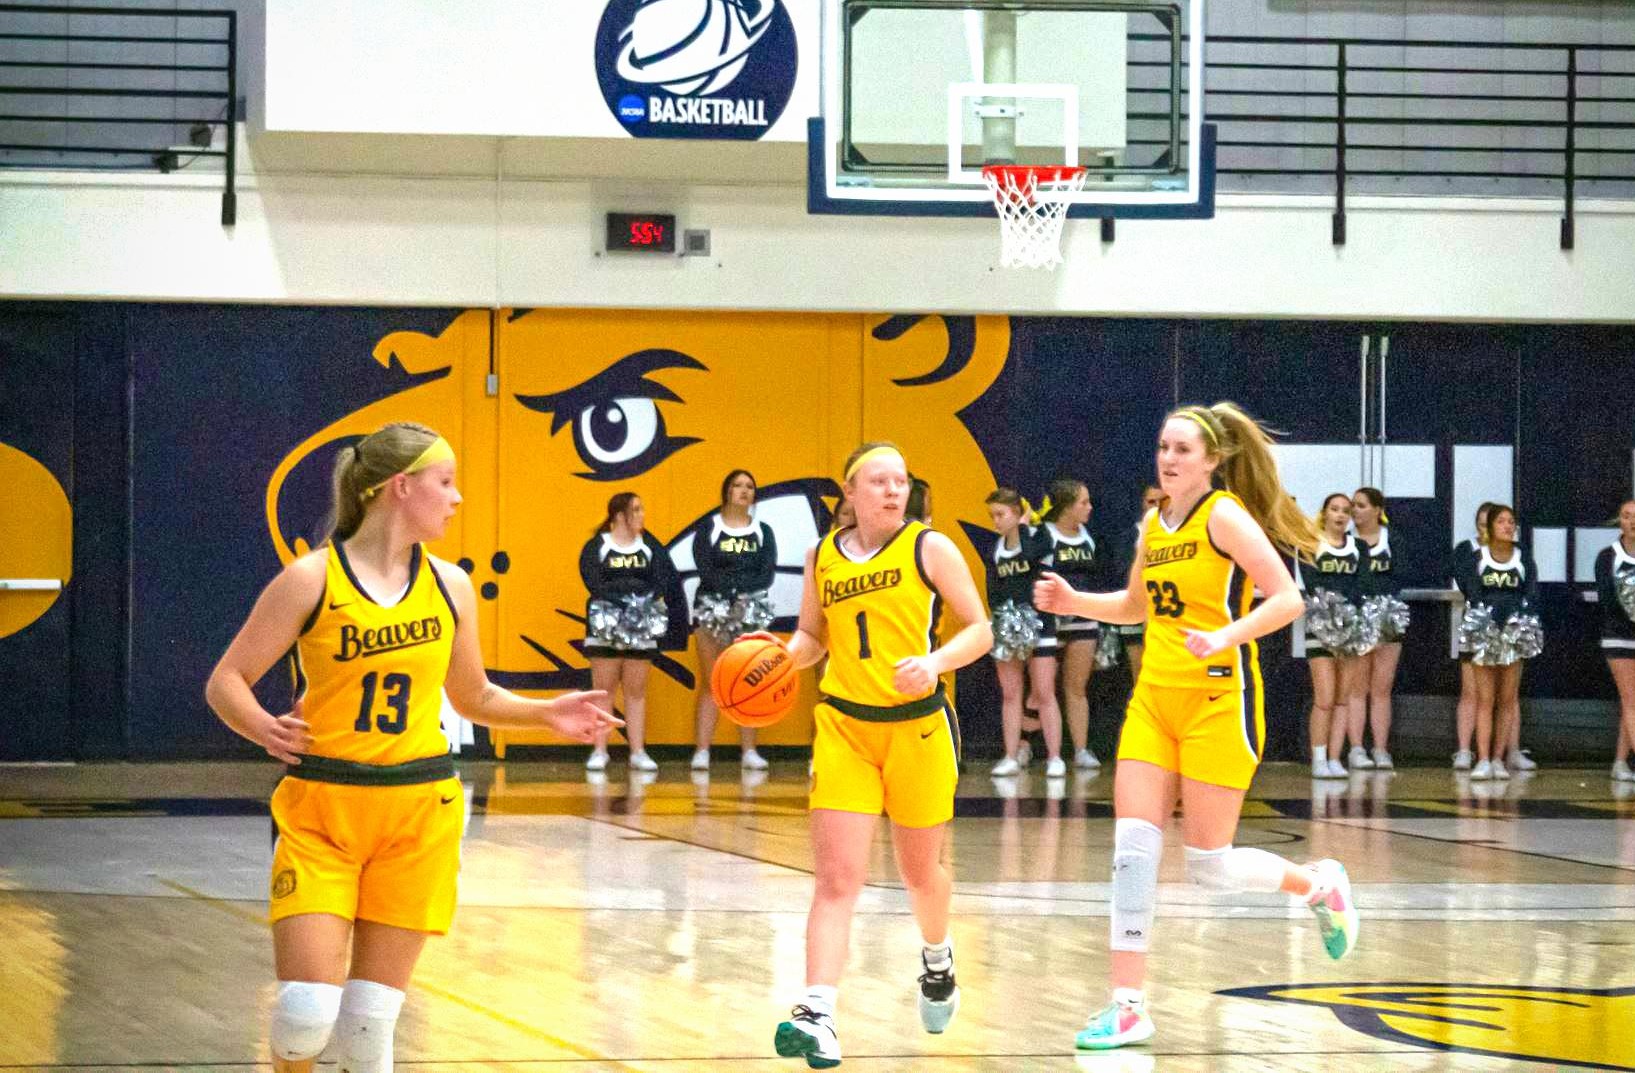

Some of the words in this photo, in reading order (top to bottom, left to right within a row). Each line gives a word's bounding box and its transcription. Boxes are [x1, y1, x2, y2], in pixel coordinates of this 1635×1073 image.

[649, 96, 768, 126] BASKETBALL
[998, 560, 1031, 578] BVU
[1321, 559, 1357, 575] BVU
[1482, 572, 1519, 588] BVU
[822, 567, 902, 608] Beavers
[1146, 580, 1185, 618] 23
[332, 615, 442, 662] Beavers
[855, 610, 872, 660] 1
[354, 670, 412, 735] 13
